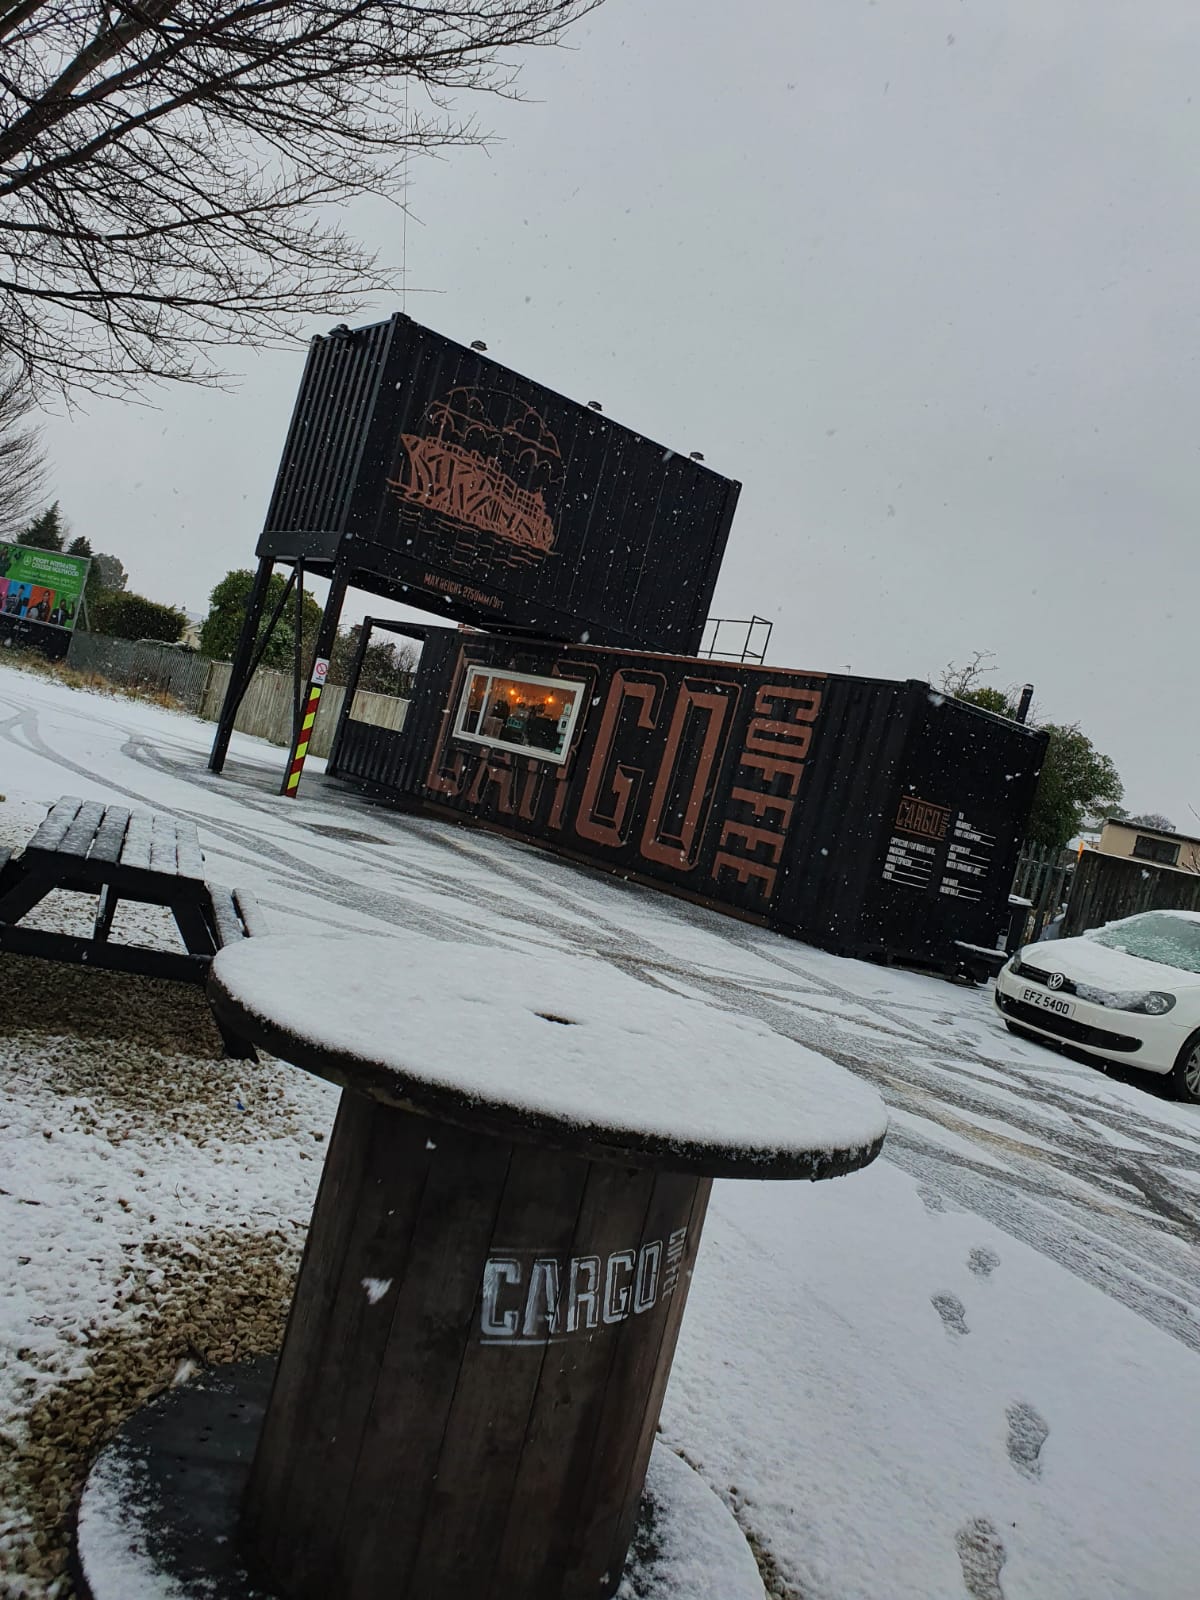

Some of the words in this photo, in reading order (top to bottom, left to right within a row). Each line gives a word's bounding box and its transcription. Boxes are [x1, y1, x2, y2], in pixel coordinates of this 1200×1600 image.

[424, 573, 440, 587] MAX
[440, 578, 462, 593] HEIGHT
[711, 684, 822, 898] COFFEE
[896, 800, 940, 835] CARGO
[1023, 989, 1042, 1005] EFZ
[1043, 997, 1070, 1014] 5400
[481, 1240, 663, 1336] CARGO
[661, 1226, 687, 1301] COFFEE
